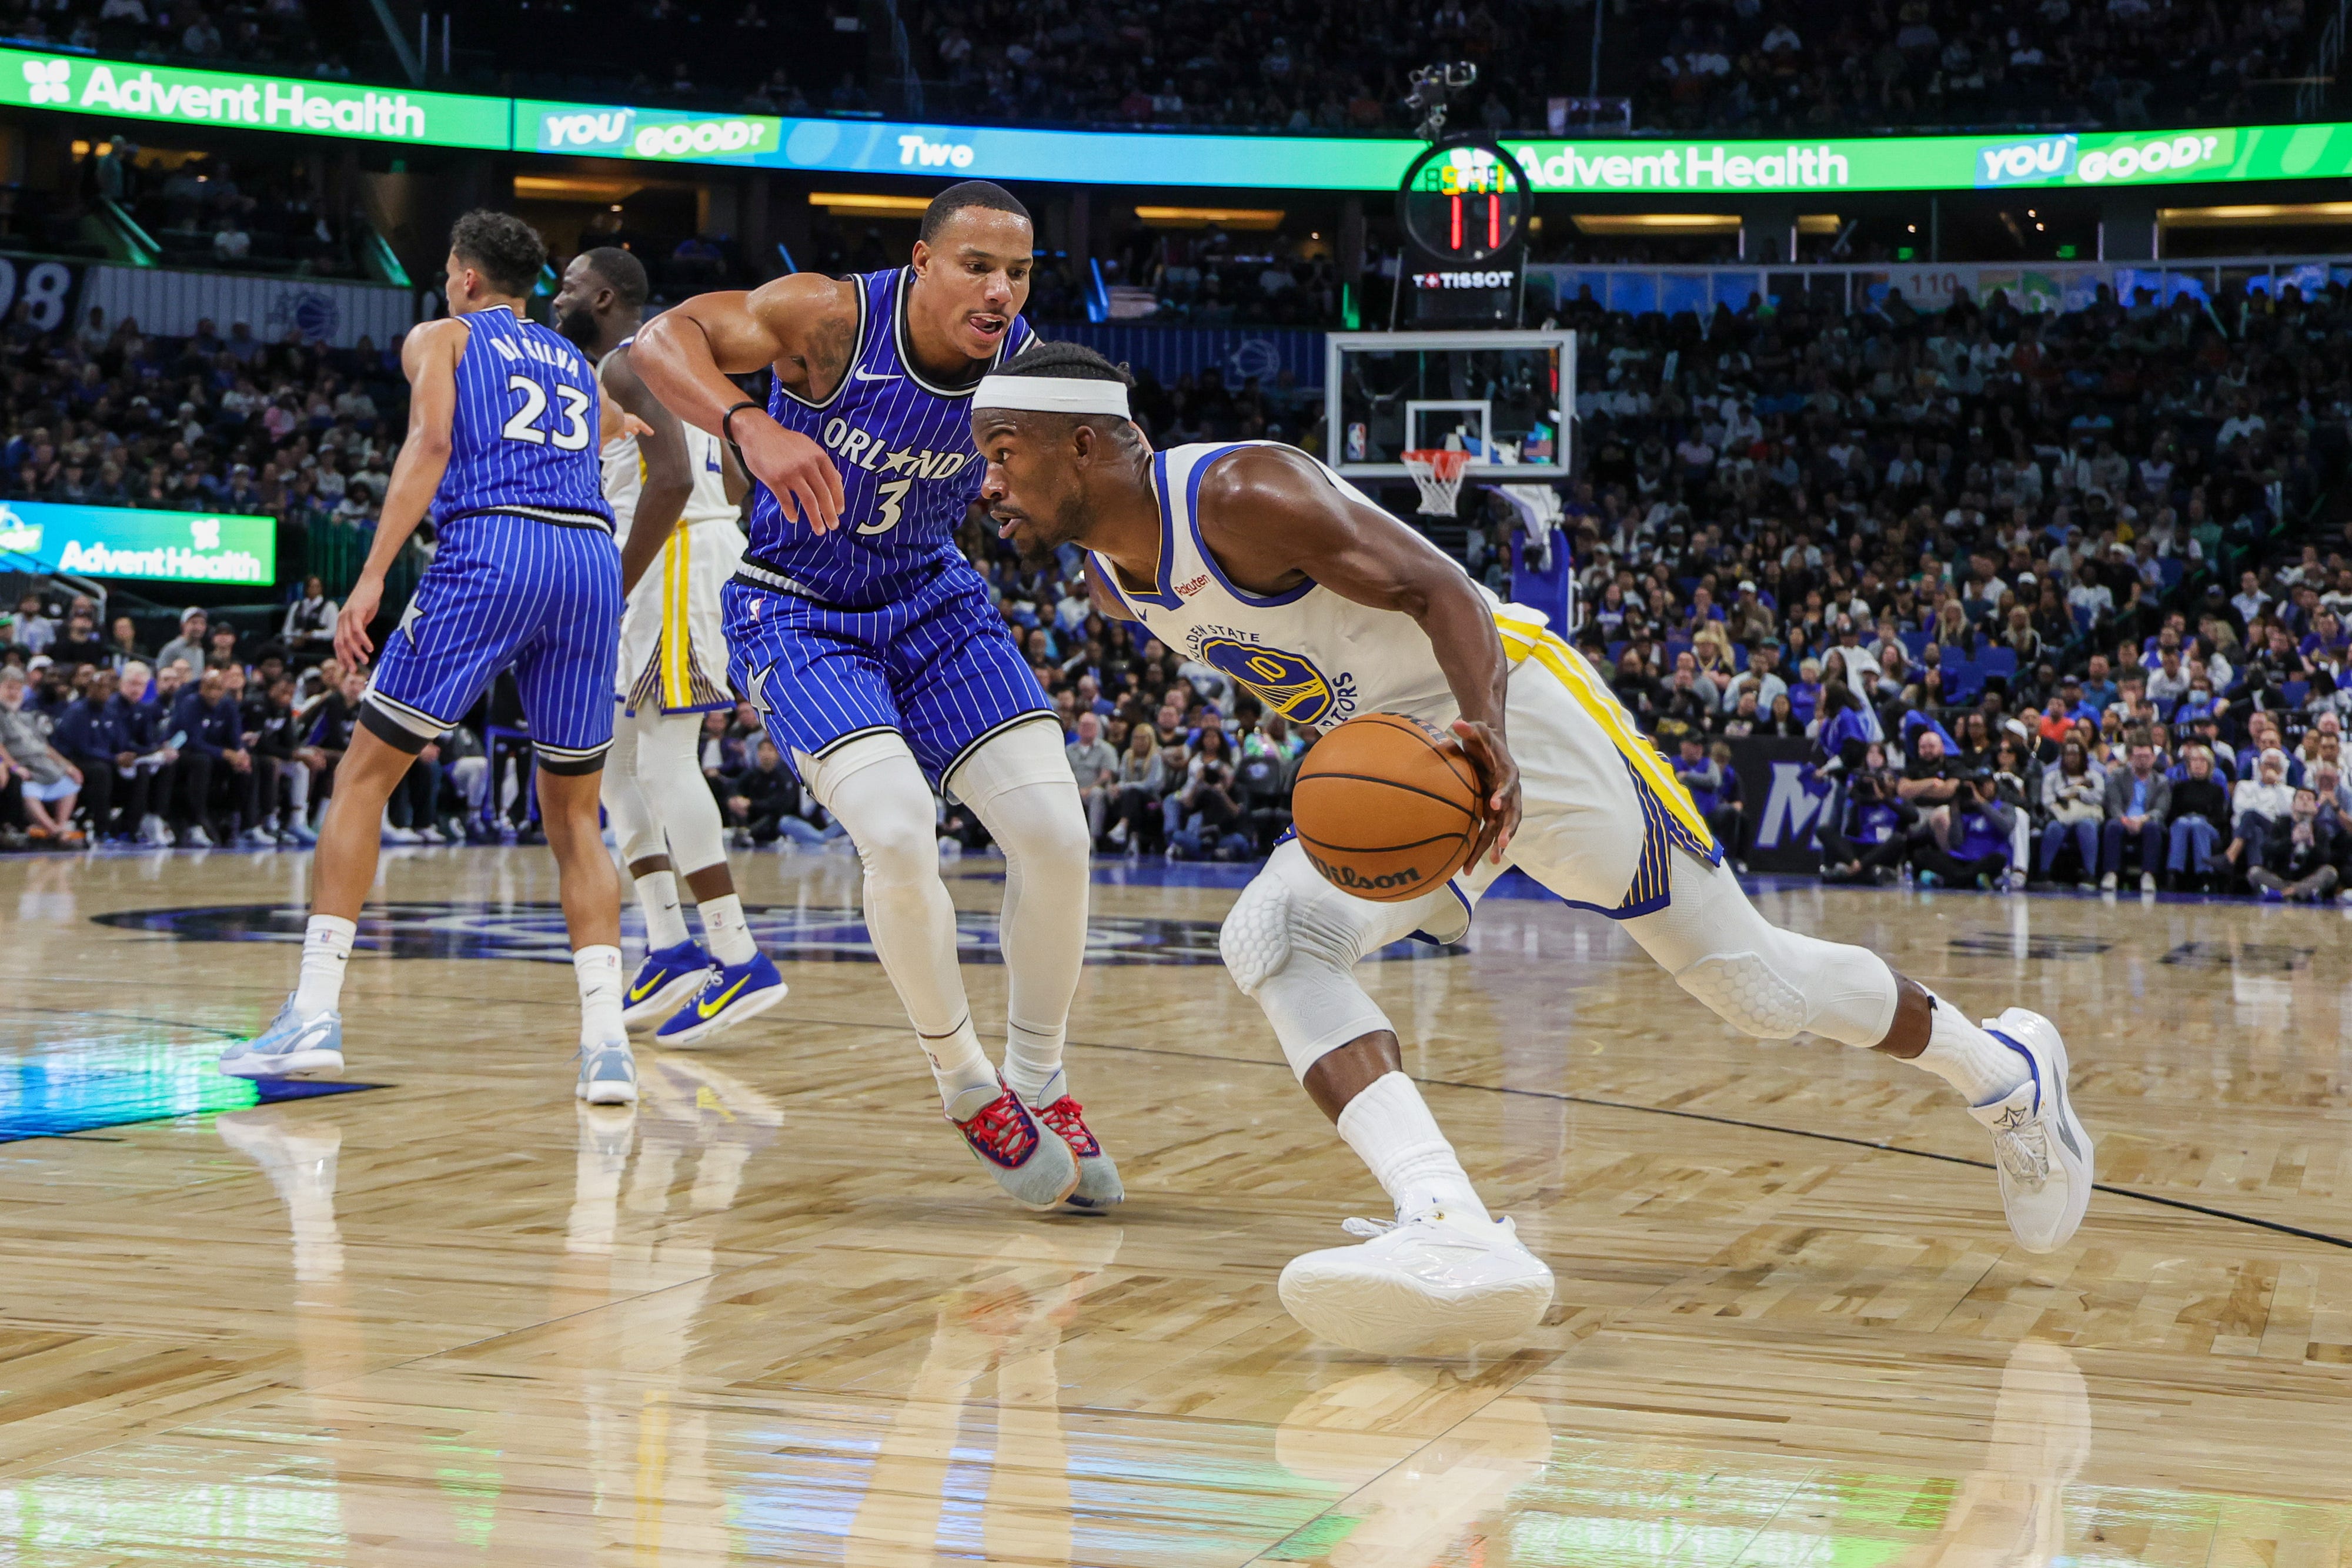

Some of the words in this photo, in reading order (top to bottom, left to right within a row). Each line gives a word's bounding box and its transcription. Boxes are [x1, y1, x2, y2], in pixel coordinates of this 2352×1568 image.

[80, 66, 425, 138] AdventHealth
[547, 112, 627, 146] YOU
[634, 121, 765, 156] GOOD?
[898, 135, 974, 167] Two
[1506, 146, 1849, 187] AdventHealth
[1983, 140, 2067, 180] YOU
[2077, 136, 2217, 183] GOOD?
[1451, 194, 1501, 250] 11
[1439, 271, 1514, 289] TISSOT
[522, 337, 580, 378] SILVA
[503, 375, 590, 452] 23
[856, 479, 912, 536] 3
[59, 540, 260, 580] AdventHealth
[1174, 574, 1211, 596] Rakuten
[1207, 624, 1260, 642] STATE
[1245, 656, 1287, 683] 10
[1303, 844, 1421, 890] Wilson
